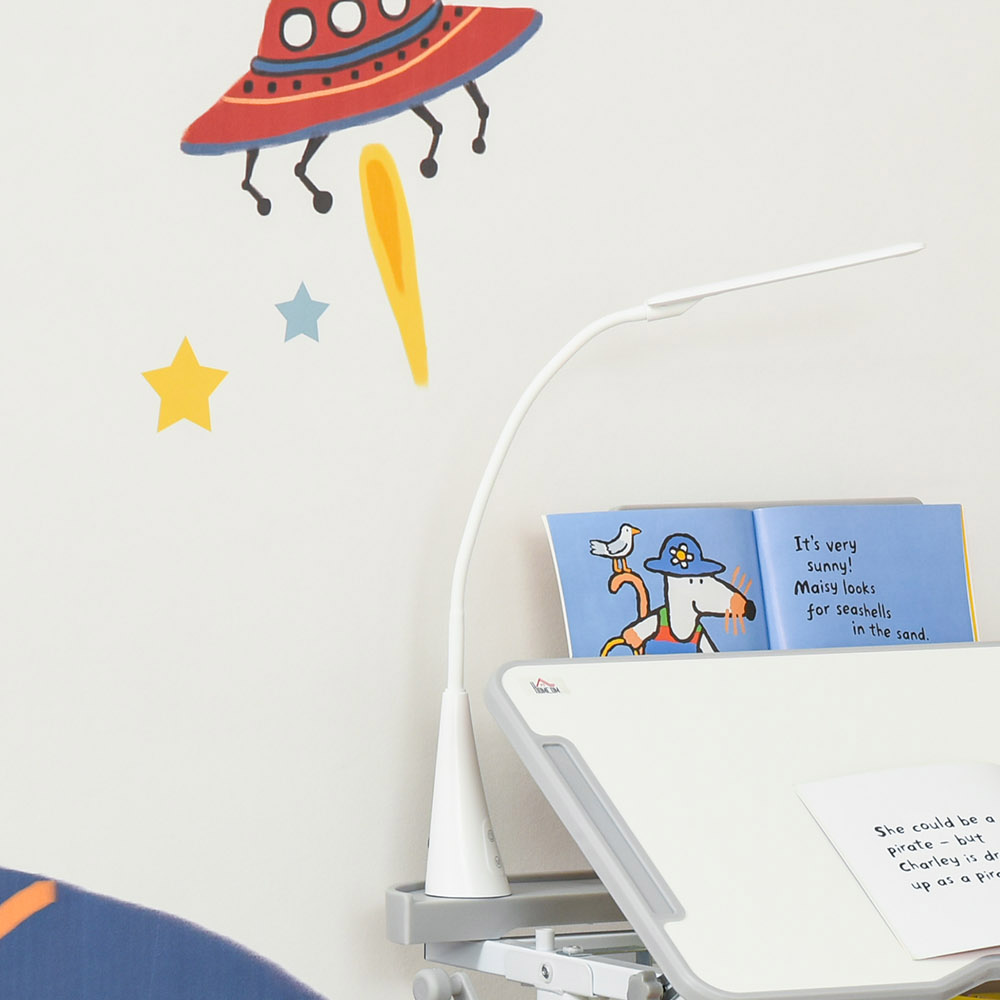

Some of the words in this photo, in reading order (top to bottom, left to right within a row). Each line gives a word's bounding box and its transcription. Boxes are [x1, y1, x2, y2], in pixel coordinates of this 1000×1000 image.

[794, 534, 820, 551] It's
[826, 540, 857, 554] very
[807, 556, 852, 575] sunny!
[794, 579, 838, 595] Maisy
[843, 579, 876, 595] looks
[807, 603, 830, 621] for
[836, 602, 892, 619] seashells
[851, 620, 865, 635] in
[869, 622, 891, 638] the
[896, 627, 930, 641] sand.
[874, 825, 905, 837] She
[912, 817, 955, 833] could
[957, 815, 978, 827] be
[985, 814, 996, 824] a
[887, 839, 934, 858] pirate
[954, 833, 985, 847] but
[899, 855, 960, 873] Charley
[963, 853, 978, 864] is
[911, 880, 931, 893] up
[937, 875, 954, 887] as
[960, 874, 971, 883] a
